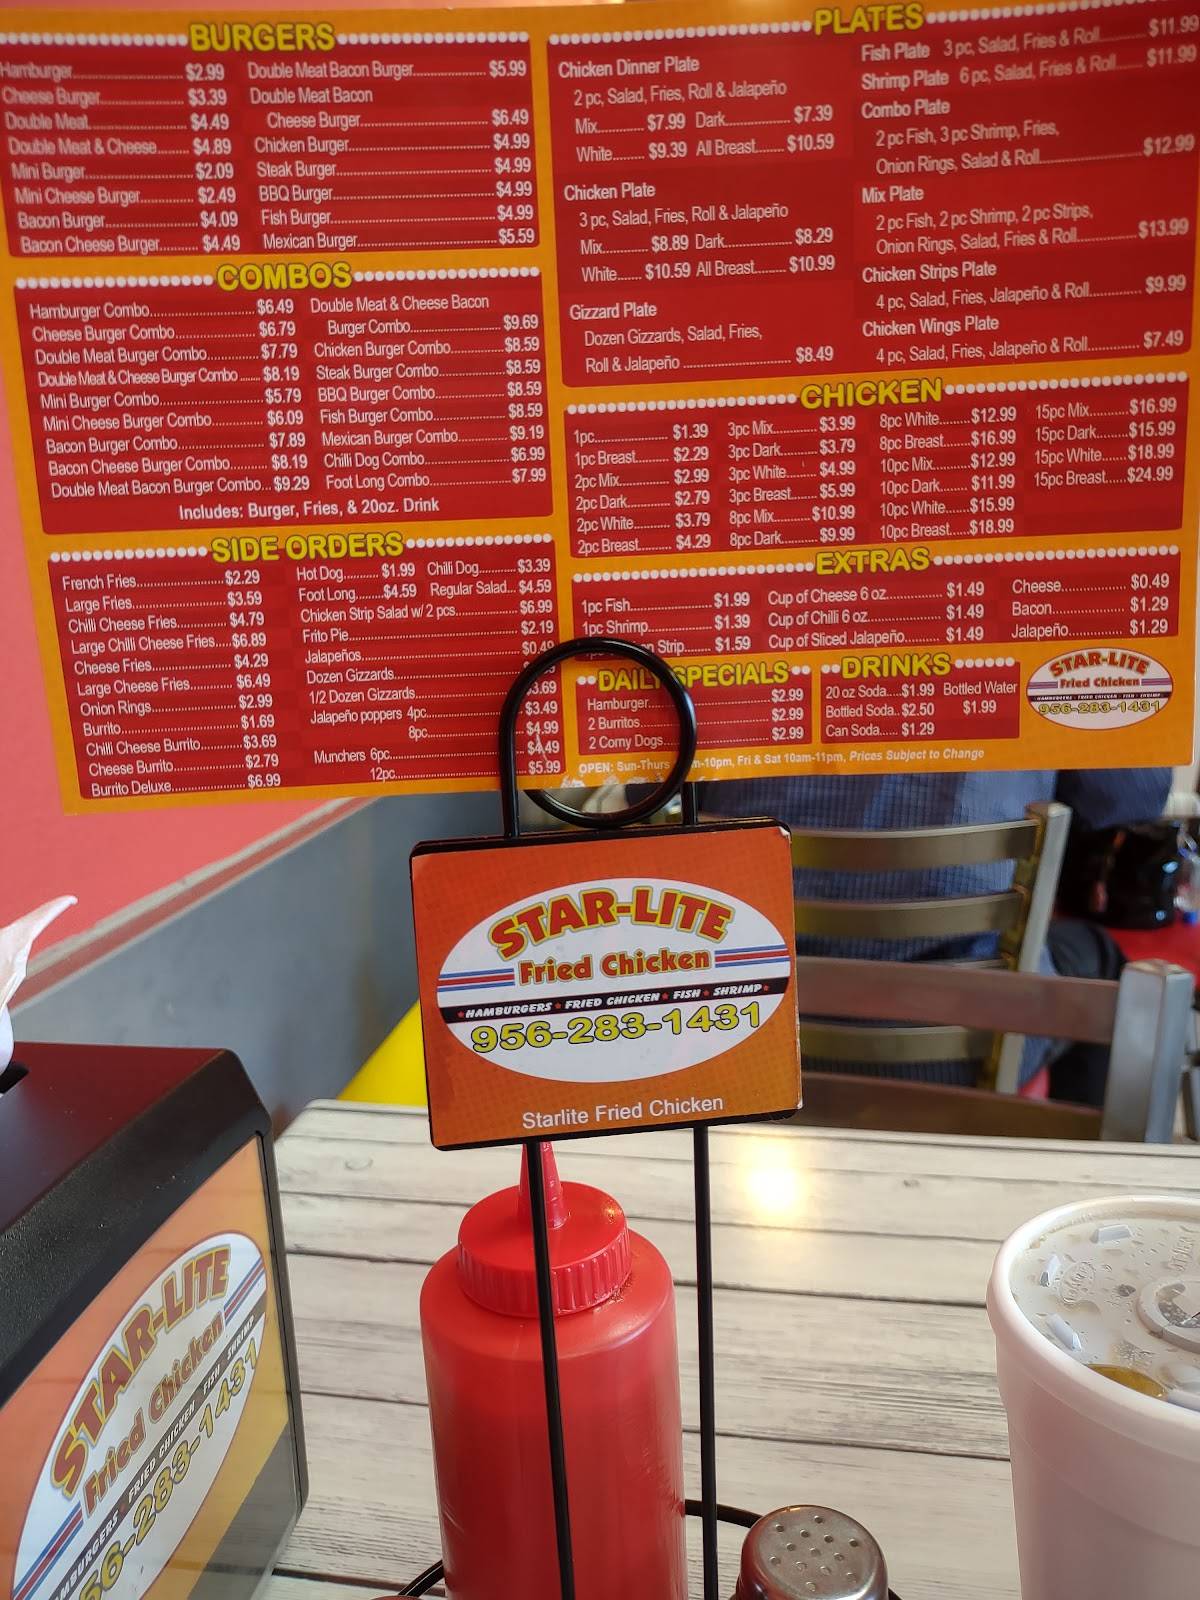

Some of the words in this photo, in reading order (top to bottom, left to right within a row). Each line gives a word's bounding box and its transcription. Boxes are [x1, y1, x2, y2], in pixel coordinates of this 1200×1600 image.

[812, 4, 924, 35] PLATES
[189, 22, 335, 51] BURGERS
[558, 60, 613, 79] Chicken
[617, 58, 660, 76] Dinner
[664, 56, 699, 73] Plate
[861, 102, 910, 119] Combo
[914, 100, 949, 115] Plate
[576, 119, 597, 134] Mix
[647, 113, 686, 132] $7.99
[259, 186, 289, 202] BBQ
[292, 186, 332, 204] Burger
[496, 181, 532, 198] $4.99
[18, 212, 59, 229] Bacon
[62, 212, 105, 232] Burger
[201, 211, 238, 228] $4.09
[263, 234, 314, 250] Mexican
[317, 233, 357, 251] Burger
[498, 228, 534, 245] $5.59
[217, 263, 352, 292] COMBOS
[582, 266, 617, 281] White
[645, 262, 691, 281] $10.59
[862, 265, 916, 284] Chicken
[920, 263, 958, 281] Strips
[962, 261, 996, 277] Plate
[30, 303, 100, 322] Hamburger
[104, 303, 150, 318] Combo
[257, 298, 294, 316] $6.49
[570, 305, 619, 321] Gizzard
[623, 302, 657, 318] Plate
[585, 331, 624, 347] Dozen
[628, 328, 684, 344] Gizzards,
[687, 326, 726, 341] Salad,
[729, 324, 762, 340] Fries,
[862, 320, 915, 338] Chicken
[919, 318, 961, 336] Wings
[965, 315, 999, 331] Plate
[876, 350, 885, 364] 4
[909, 345, 949, 362] Salad,
[952, 343, 986, 360] Fries,
[989, 339, 1046, 358] Jalapeño
[1050, 338, 1059, 353] &
[1063, 336, 1088, 352] Roll
[1144, 330, 1184, 351] $7.49
[586, 358, 609, 373] Roll
[612, 357, 622, 372] &
[625, 355, 680, 373] Jalapeño
[796, 346, 834, 363] $8.49
[40, 394, 68, 409] Mini
[71, 392, 110, 411] Burger
[114, 392, 160, 406] Combo
[264, 388, 302, 405] $5.79
[800, 378, 942, 411] CHICKEN
[574, 429, 594, 446] 1pc
[672, 424, 709, 441] $1.39
[326, 475, 352, 489] Foot
[355, 475, 385, 491] Long
[388, 474, 430, 488] Combo
[511, 468, 546, 485] $7.99
[881, 478, 909, 497] 10pc
[912, 476, 940, 493] Dark
[971, 474, 1015, 492] $11.99
[1034, 471, 1063, 489] 15pc
[1066, 469, 1106, 486] Breast
[1127, 466, 1173, 484] $24.99
[179, 505, 243, 520] Includes:
[248, 502, 299, 522] Burger,
[303, 500, 343, 518] Fries,
[347, 500, 357, 514] &
[361, 498, 399, 515] 20oz.
[403, 497, 439, 513] Drink
[730, 510, 751, 527] 8pc
[754, 508, 774, 523] Mix
[812, 505, 856, 522] $10.99
[577, 518, 598, 534] 2pc
[600, 515, 634, 531] White
[675, 512, 710, 530] $3.79
[211, 537, 280, 563] SIDE
[286, 532, 404, 560] ORDERS
[297, 567, 317, 581] Hot
[320, 565, 344, 582] Dog
[382, 563, 415, 580] $1.99
[428, 562, 453, 576] Chilli
[456, 561, 479, 577] Dog
[517, 558, 551, 575] $3.39
[815, 546, 931, 576] EXTRAS
[63, 576, 104, 590] French
[107, 574, 137, 588] Fries
[225, 569, 260, 586] $2.29
[1012, 579, 1061, 595] Cheese
[1131, 573, 1170, 592] $0.49
[301, 608, 346, 623] Chicken
[349, 606, 374, 623] Strip
[377, 604, 408, 619] Salad
[426, 603, 434, 617] 2
[437, 606, 456, 619] pcs
[520, 600, 552, 615] $6.99
[582, 600, 603, 614] 1pc
[606, 598, 630, 612] Fish
[714, 592, 750, 609] $1.99
[1012, 601, 1052, 617] Bacon
[1130, 596, 1169, 614] $1.29
[305, 649, 361, 665] Jalapeños
[842, 651, 951, 679] DRINKS
[1050, 651, 1149, 677] STAR-LITE
[826, 686, 841, 699] 20
[842, 688, 855, 699] oz
[858, 684, 887, 698] Soda
[901, 682, 934, 699] $1.99
[1060, 678, 1090, 688] Fried
[1094, 678, 1140, 688] Chicken
[80, 701, 115, 717] Onion
[118, 699, 152, 717] Rings
[238, 694, 273, 710] $2.99
[588, 717, 596, 730] 2
[598, 716, 640, 730] Burritos
[772, 708, 804, 722] $2.99
[579, 762, 613, 774] OPEN:
[737, 755, 750, 766] Fri
[850, 750, 882, 761] Prices
[886, 749, 926, 762] Subject
[930, 749, 939, 759] to
[943, 748, 984, 759] Change
[92, 782, 129, 796] Burrito
[132, 780, 172, 794] Deluxe
[248, 773, 281, 789] $6.99
[488, 886, 735, 960] STAR-LITE
[518, 955, 594, 986] Fried
[600, 948, 711, 978] Chicken
[466, 1002, 552, 1019] HAMBURGERS
[565, 998, 602, 1009] FRIED
[606, 993, 660, 1005] CHICKEN
[673, 988, 701, 1000] FISH
[713, 984, 762, 996] SHRIMP
[471, 1001, 760, 1053] 956-283-1431
[522, 1111, 589, 1129] Starlite
[596, 1104, 643, 1122] Fried
[649, 1095, 723, 1118] Chicken
[51, 1244, 231, 1501] STAR-LITE
[79, 1337, 258, 1600] 56-283-1431
